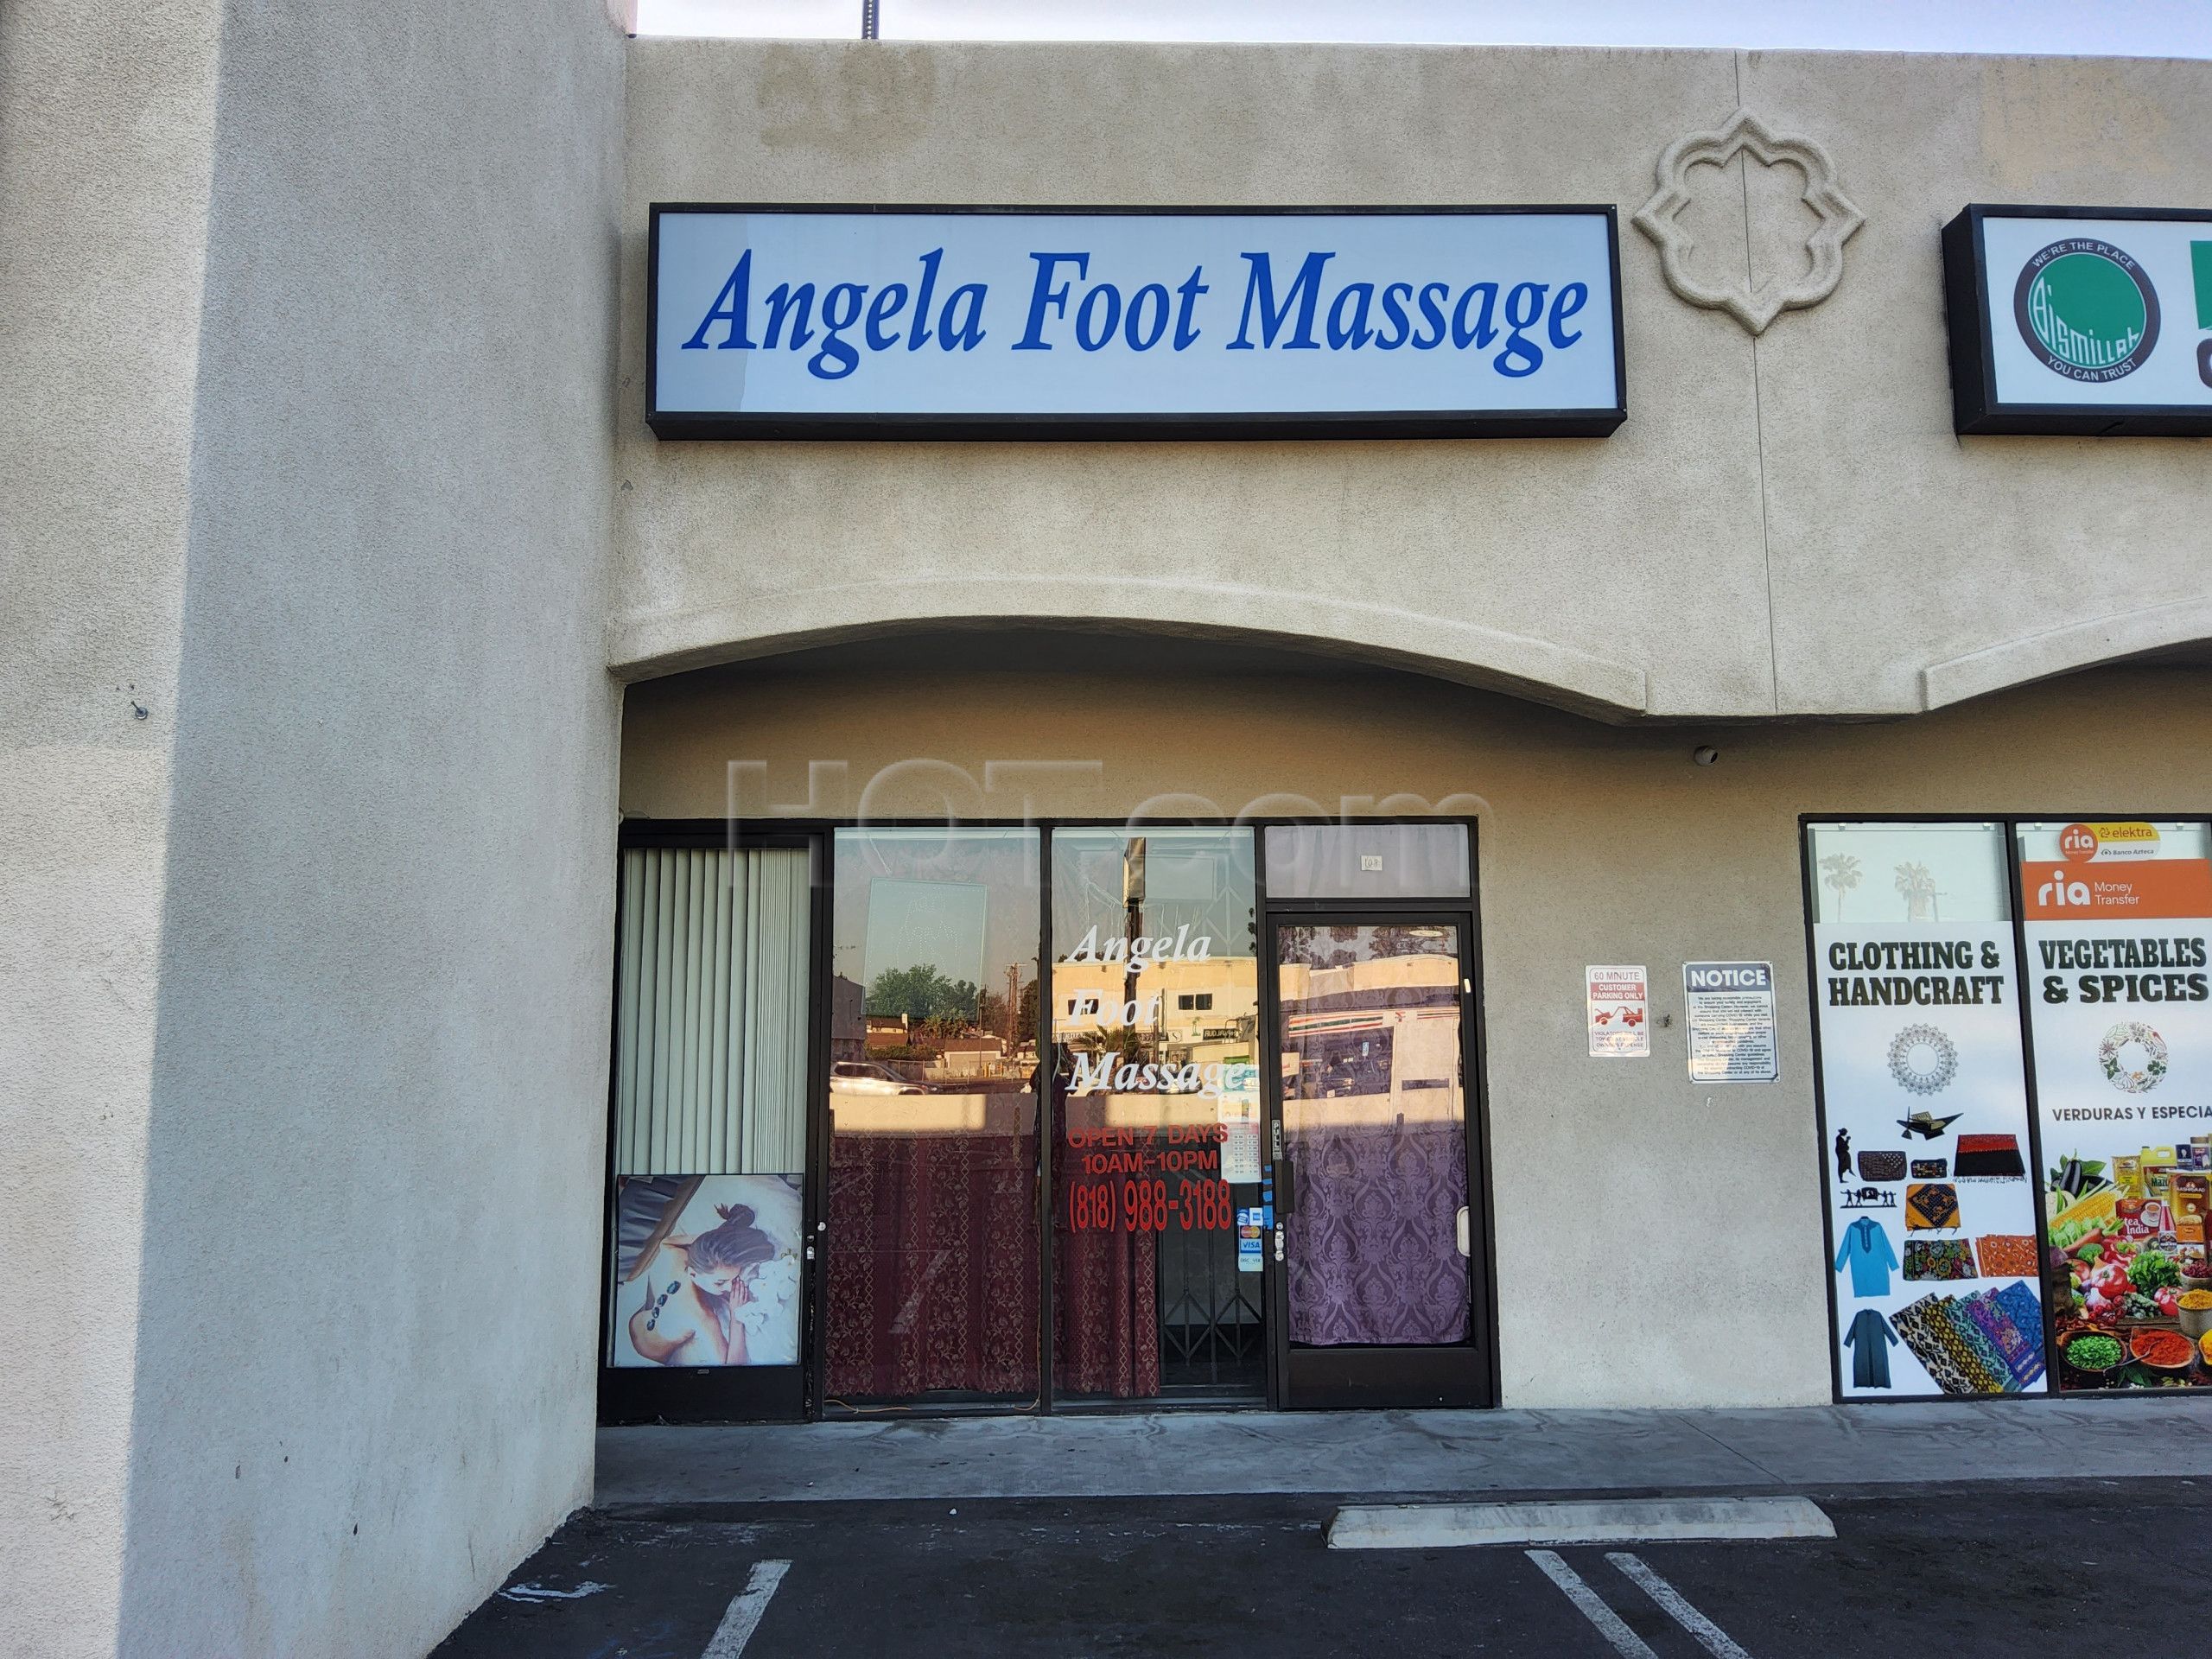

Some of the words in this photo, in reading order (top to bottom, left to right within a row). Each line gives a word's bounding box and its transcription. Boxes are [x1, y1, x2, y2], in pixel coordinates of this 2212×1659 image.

[2032, 243, 2067, 268] WE'RE
[2069, 241, 2093, 251] THE
[2097, 244, 2135, 270] PLACE
[681, 247, 988, 380] Angela
[1011, 251, 1209, 351] Foot
[1225, 251, 1588, 378] Massage
[2047, 355, 2071, 375] YOU
[2074, 368, 2099, 381] CAN
[2101, 358, 2137, 380] TRUST
[2064, 829, 2094, 849] ria
[2112, 826, 2152, 838] elektra
[2037, 870, 2091, 906] ria
[2094, 881, 2133, 894] Money
[2094, 893, 2140, 906] Transfer
[1066, 923, 1211, 974] Angela
[1828, 940, 1974, 971] CLOTHING
[1980, 939, 2000, 969] &
[2038, 938, 2207, 969] VEGETABLES
[1594, 971, 1604, 981] 60
[1606, 971, 1640, 981] MINUTE
[1691, 969, 1767, 987] NOTICE
[2043, 976, 2069, 1004] &
[2080, 973, 2209, 1003] SPICES
[1828, 975, 2005, 1007] HANDCRAFT
[1064, 988, 1160, 1027] Foot
[1065, 1052, 1247, 1100] Massage
[2052, 1107, 2133, 1122] VERDURAS
[2137, 1107, 2146, 1120] Y
[2152, 1105, 2212, 1119] ESPECIA
[1068, 1127, 1135, 1148] OPEN
[1144, 1125, 1157, 1145] 7
[1168, 1122, 1229, 1145] DAYS
[1081, 1149, 1217, 1175] 10AM-10PM
[1069, 1179, 1116, 1233] (818)
[1124, 1179, 1232, 1232] 988-3188
[2124, 1217, 2139, 1226] tea
[2126, 1225, 2150, 1235] India
[1243, 1241, 1261, 1249] VISA
